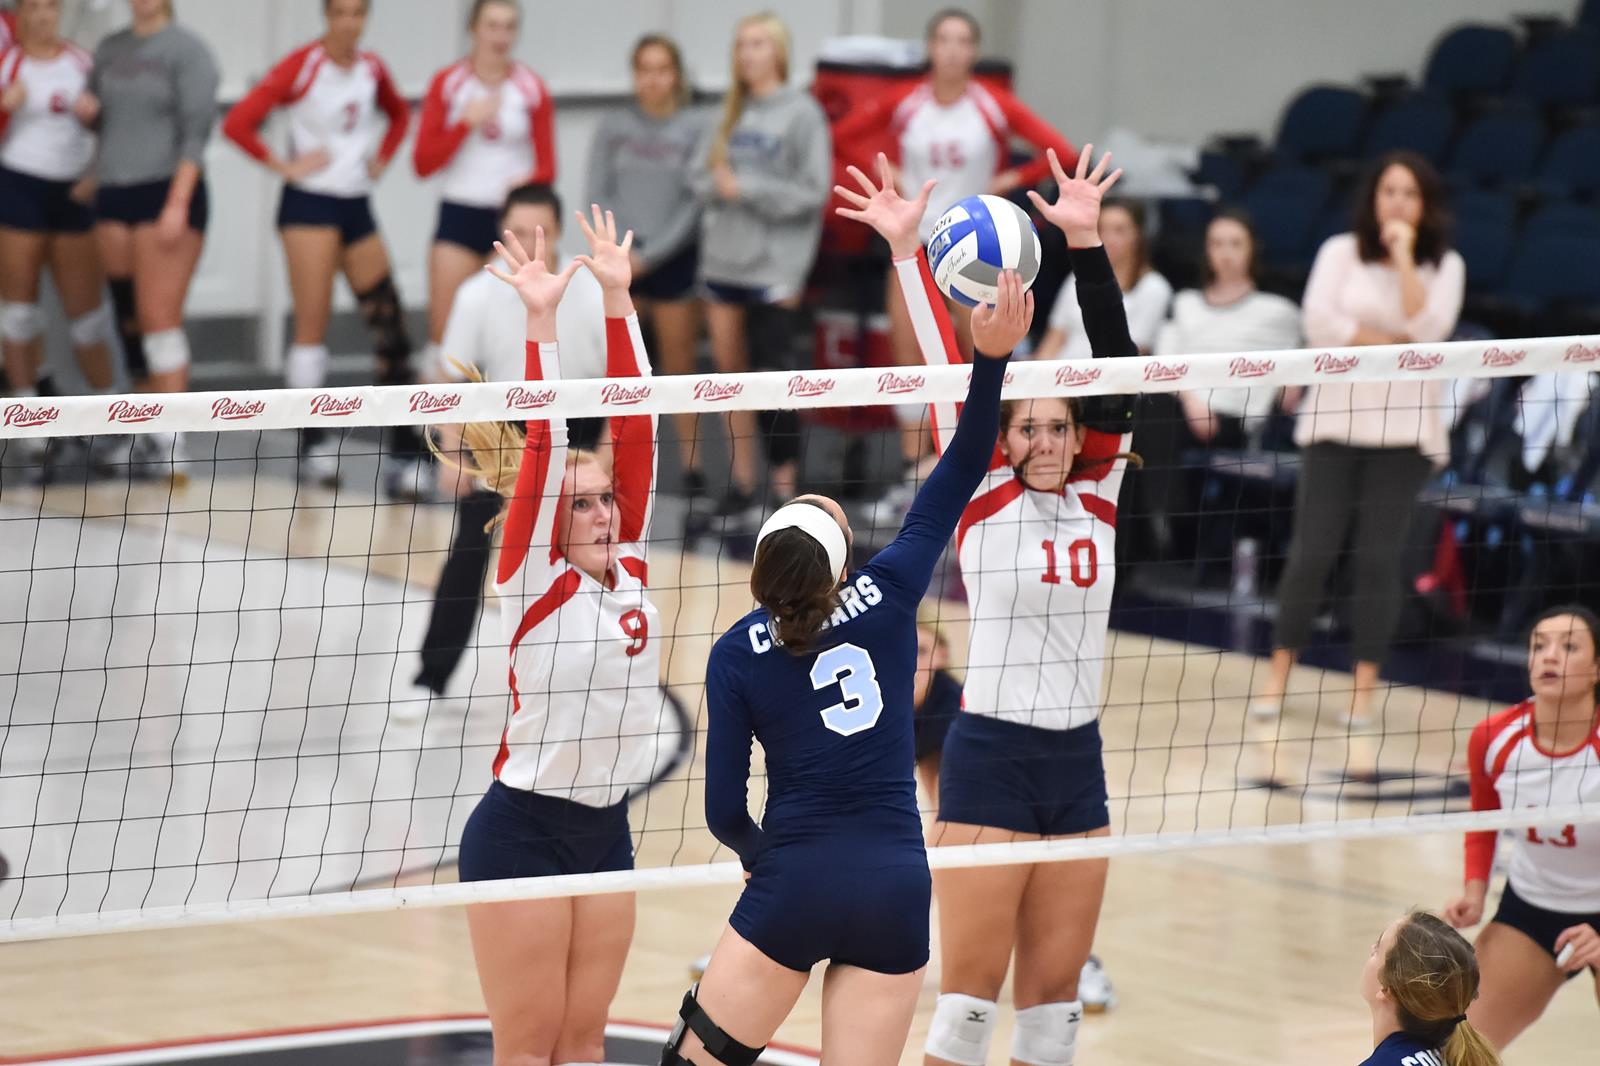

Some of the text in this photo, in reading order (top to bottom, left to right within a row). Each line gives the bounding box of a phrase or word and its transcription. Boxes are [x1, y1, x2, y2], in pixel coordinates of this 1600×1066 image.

[4, 343, 1600, 427] Patriots Patriots Patriots Patriots Patriots Patriots Patriots Patriots Patriots Patriots Patriots Patriots Patriots Patriots Patriots Patriots Patrio
[1041, 538, 1098, 588] 10
[618, 608, 648, 657] 9
[747, 574, 883, 654] COARS
[809, 642, 884, 737] 3
